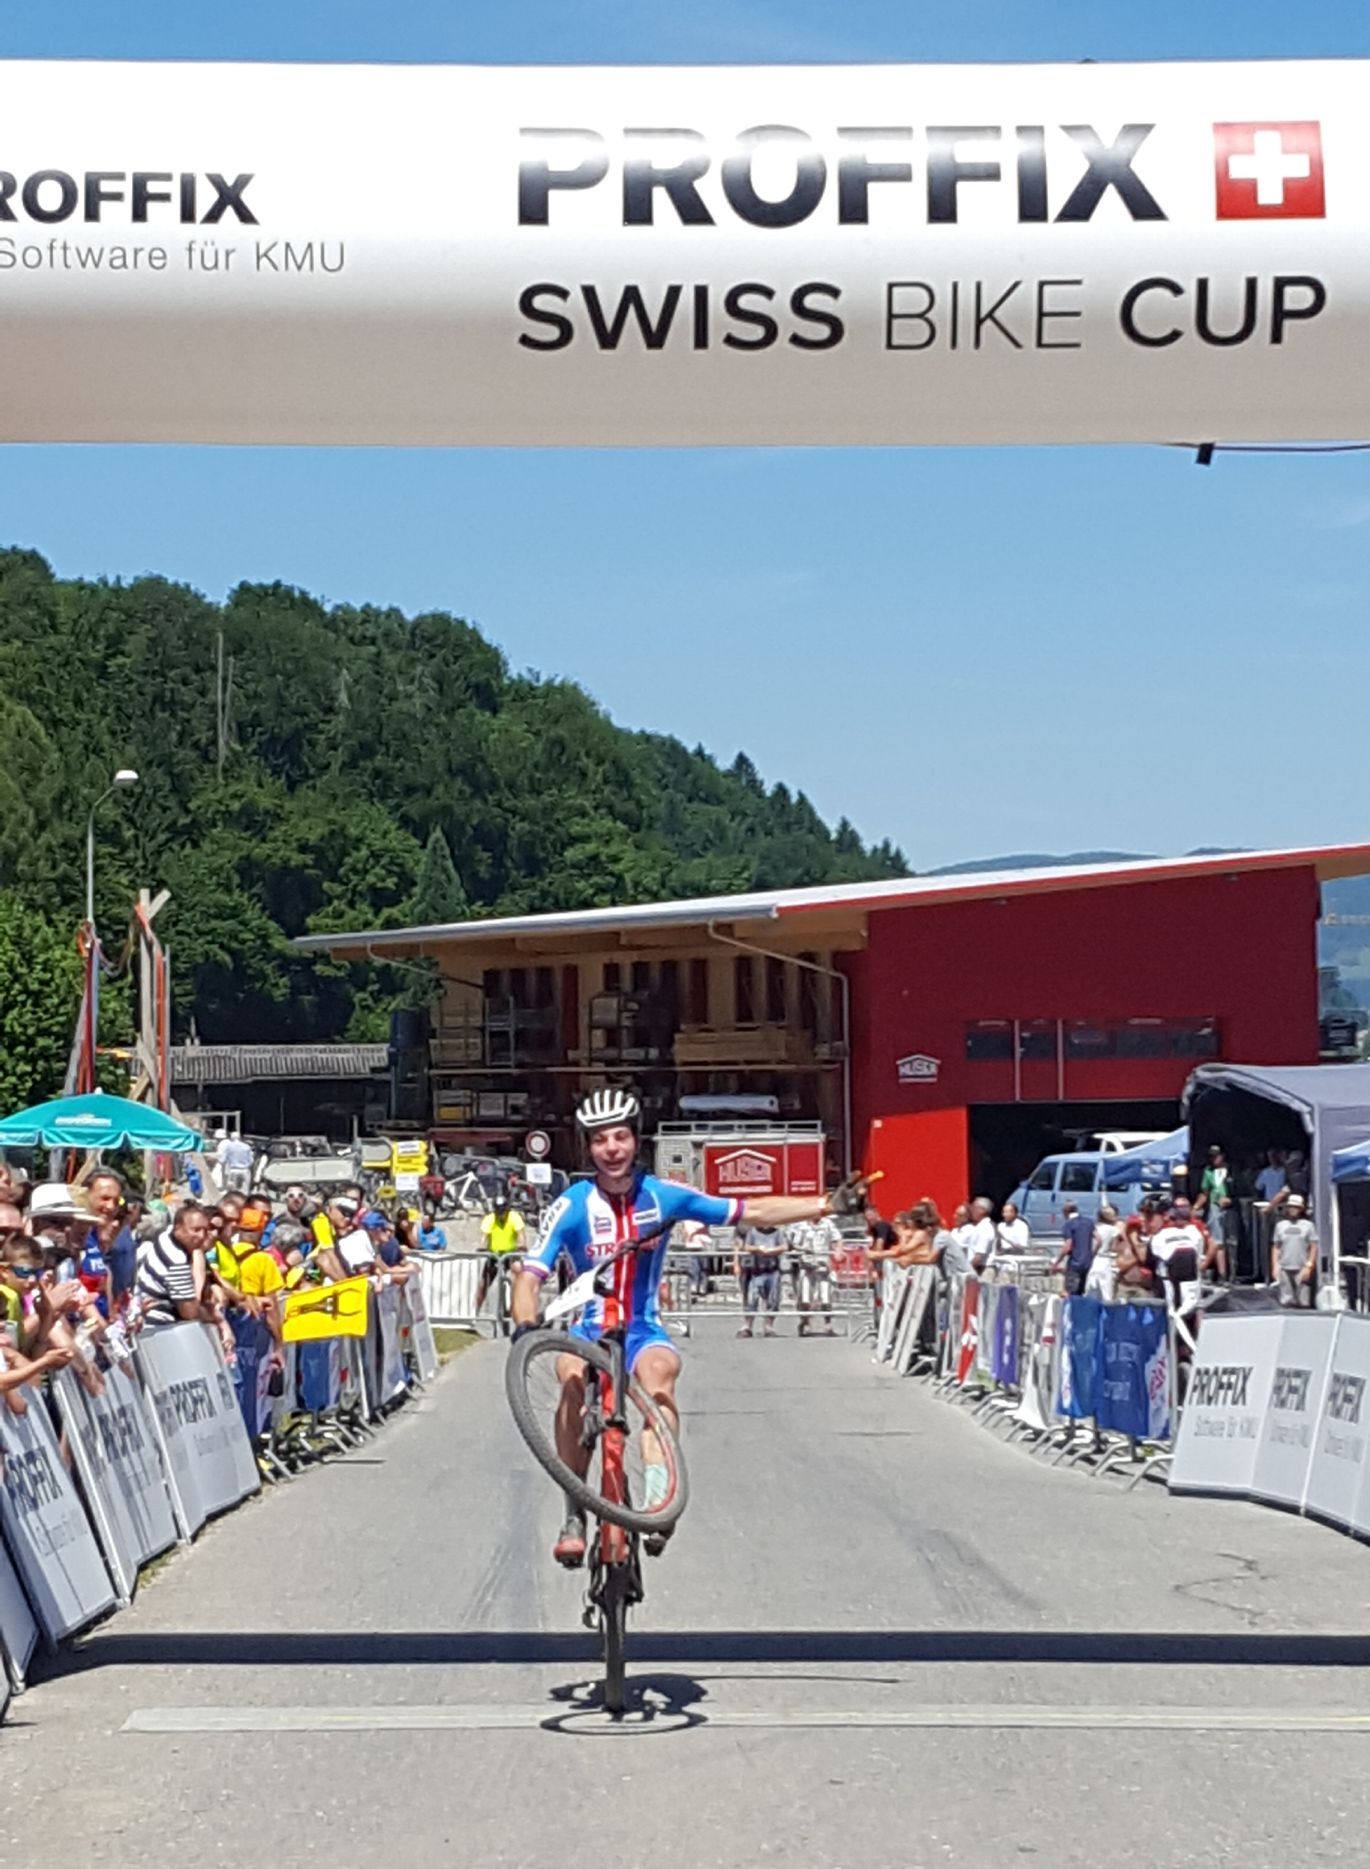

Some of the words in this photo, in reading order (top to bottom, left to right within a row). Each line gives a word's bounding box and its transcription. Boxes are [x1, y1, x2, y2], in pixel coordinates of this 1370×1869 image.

[518, 124, 1171, 228] PROFFIX
[0, 236, 168, 270] Software
[186, 240, 236, 271] für
[255, 241, 345, 272] KMU
[518, 282, 846, 351] SWISS
[885, 278, 1084, 349] BIKE
[1119, 276, 1328, 346] CUP
[1188, 1366, 1254, 1407] PROFFIX
